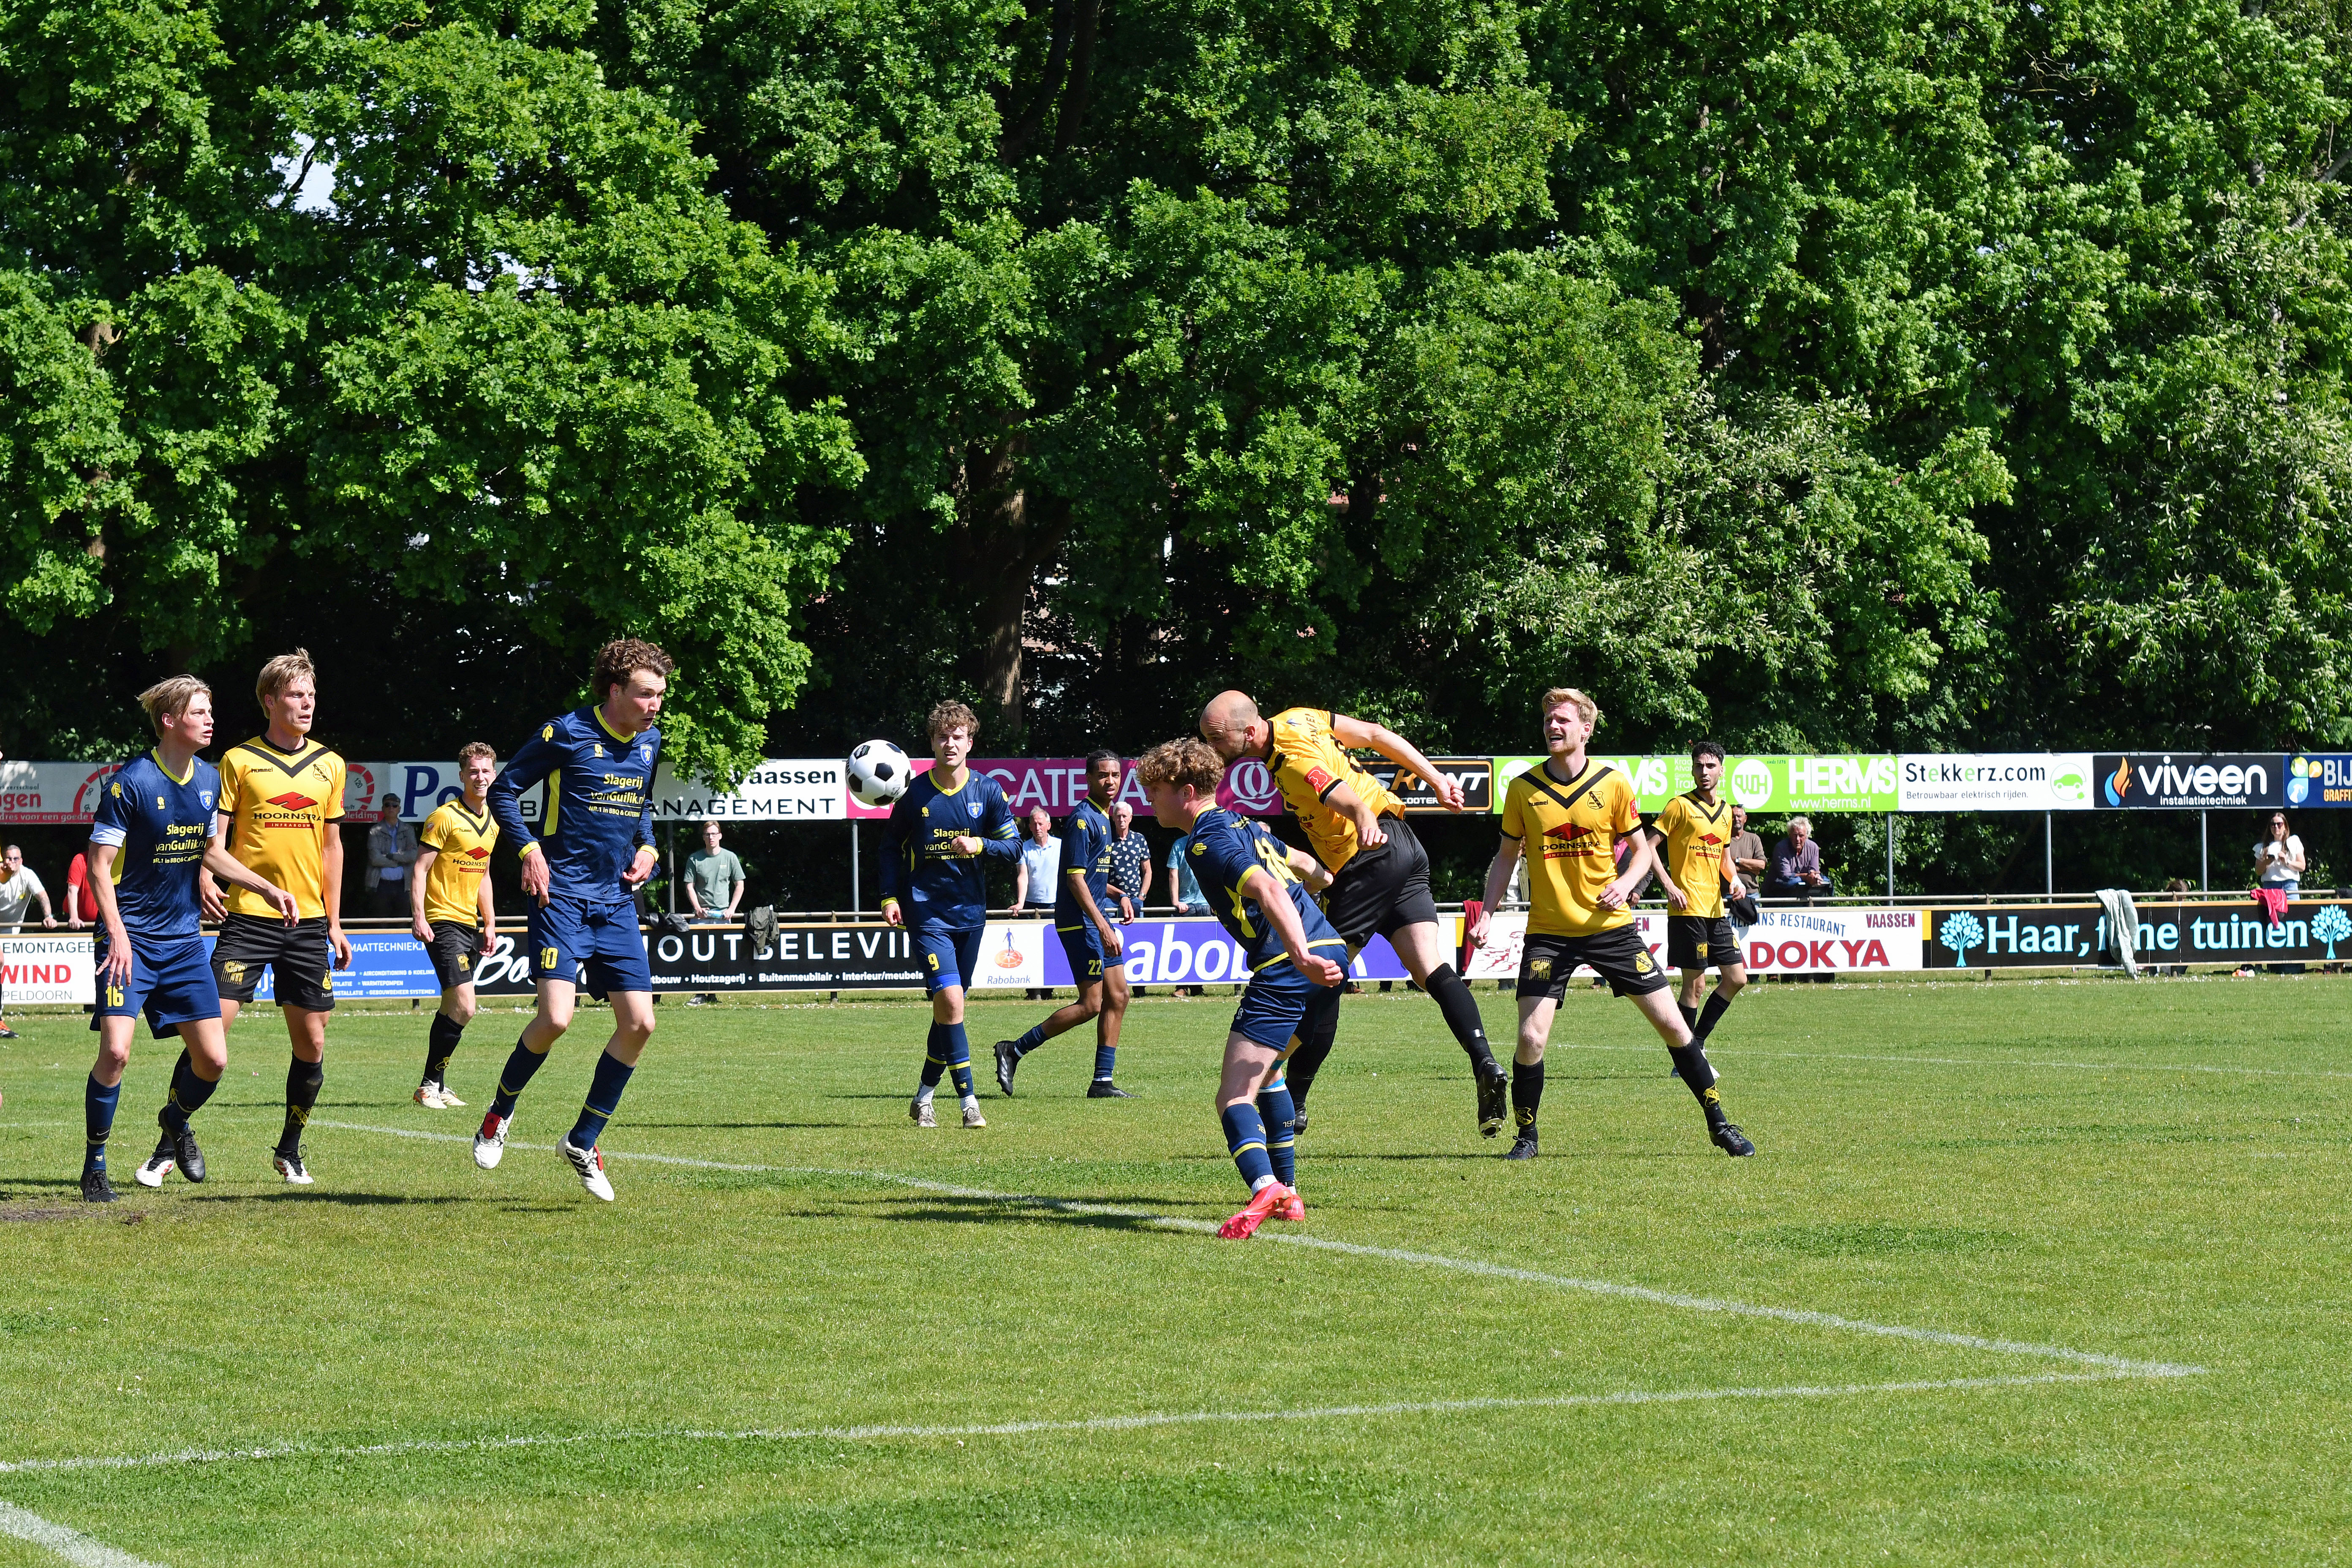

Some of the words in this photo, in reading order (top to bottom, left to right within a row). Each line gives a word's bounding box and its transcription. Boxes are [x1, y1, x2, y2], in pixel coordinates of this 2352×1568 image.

[1788, 758, 1897, 794] HERMS
[1906, 763, 2045, 782] Stekkerz.com
[2138, 756, 2267, 795] viveen
[354, 778, 362, 788] 120
[604, 774, 643, 790] Slagerij
[1790, 796, 1871, 808] www.herms.nl
[2004, 790, 2028, 800] rijden.
[649, 799, 836, 815] ANAGEMENT
[61, 812, 88, 822] goede
[254, 813, 321, 821] HOORNSTRA
[166, 823, 204, 837] Slagerij
[934, 828, 970, 839] Slagerij
[1780, 914, 1846, 937] RESTAURANT
[1866, 913, 1915, 928] VAASSEN
[1987, 916, 2080, 957] Haar,
[2095, 915, 2178, 950] fne
[2190, 913, 2308, 949] tuinen
[0, 942, 95, 953] EMONTAGEB
[1740, 939, 1890, 969] DOKYA
[541, 947, 558, 969] 10
[928, 953, 939, 971] 9
[691, 973, 746, 984] Houtzagerij
[759, 972, 833, 982] Buitenmeubilair
[842, 971, 924, 980] Interieur/meubels
[987, 975, 1031, 985] Rabobank
[2, 991, 72, 1000] PELDOORN
[106, 985, 124, 1007] 16
